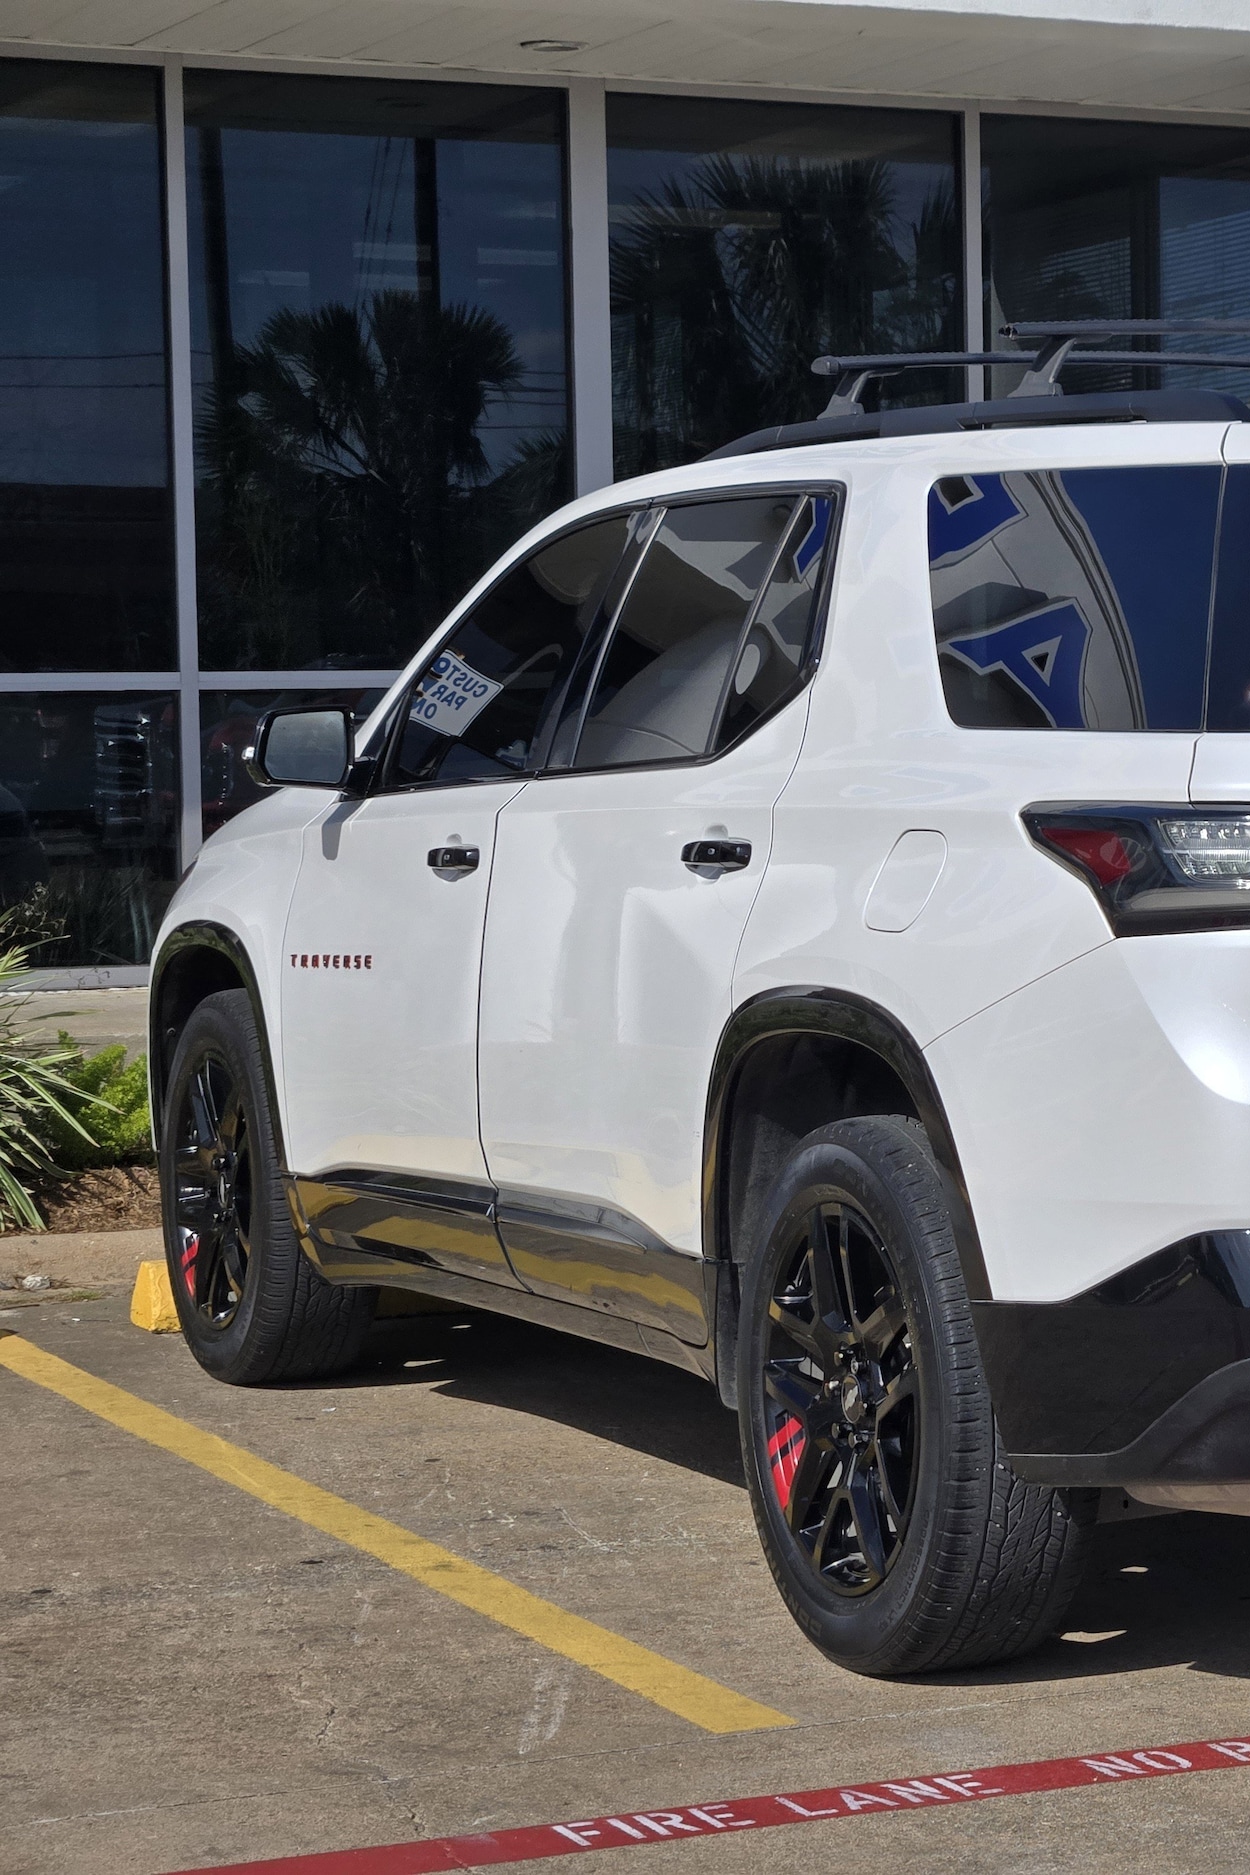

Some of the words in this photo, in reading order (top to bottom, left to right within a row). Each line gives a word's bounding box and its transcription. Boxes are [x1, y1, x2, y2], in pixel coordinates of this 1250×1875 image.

[290, 954, 372, 970] TRAVERSE
[552, 1803, 756, 1847] FIRE
[774, 1773, 1005, 1818] LANE
[1080, 1750, 1192, 1778] NO
